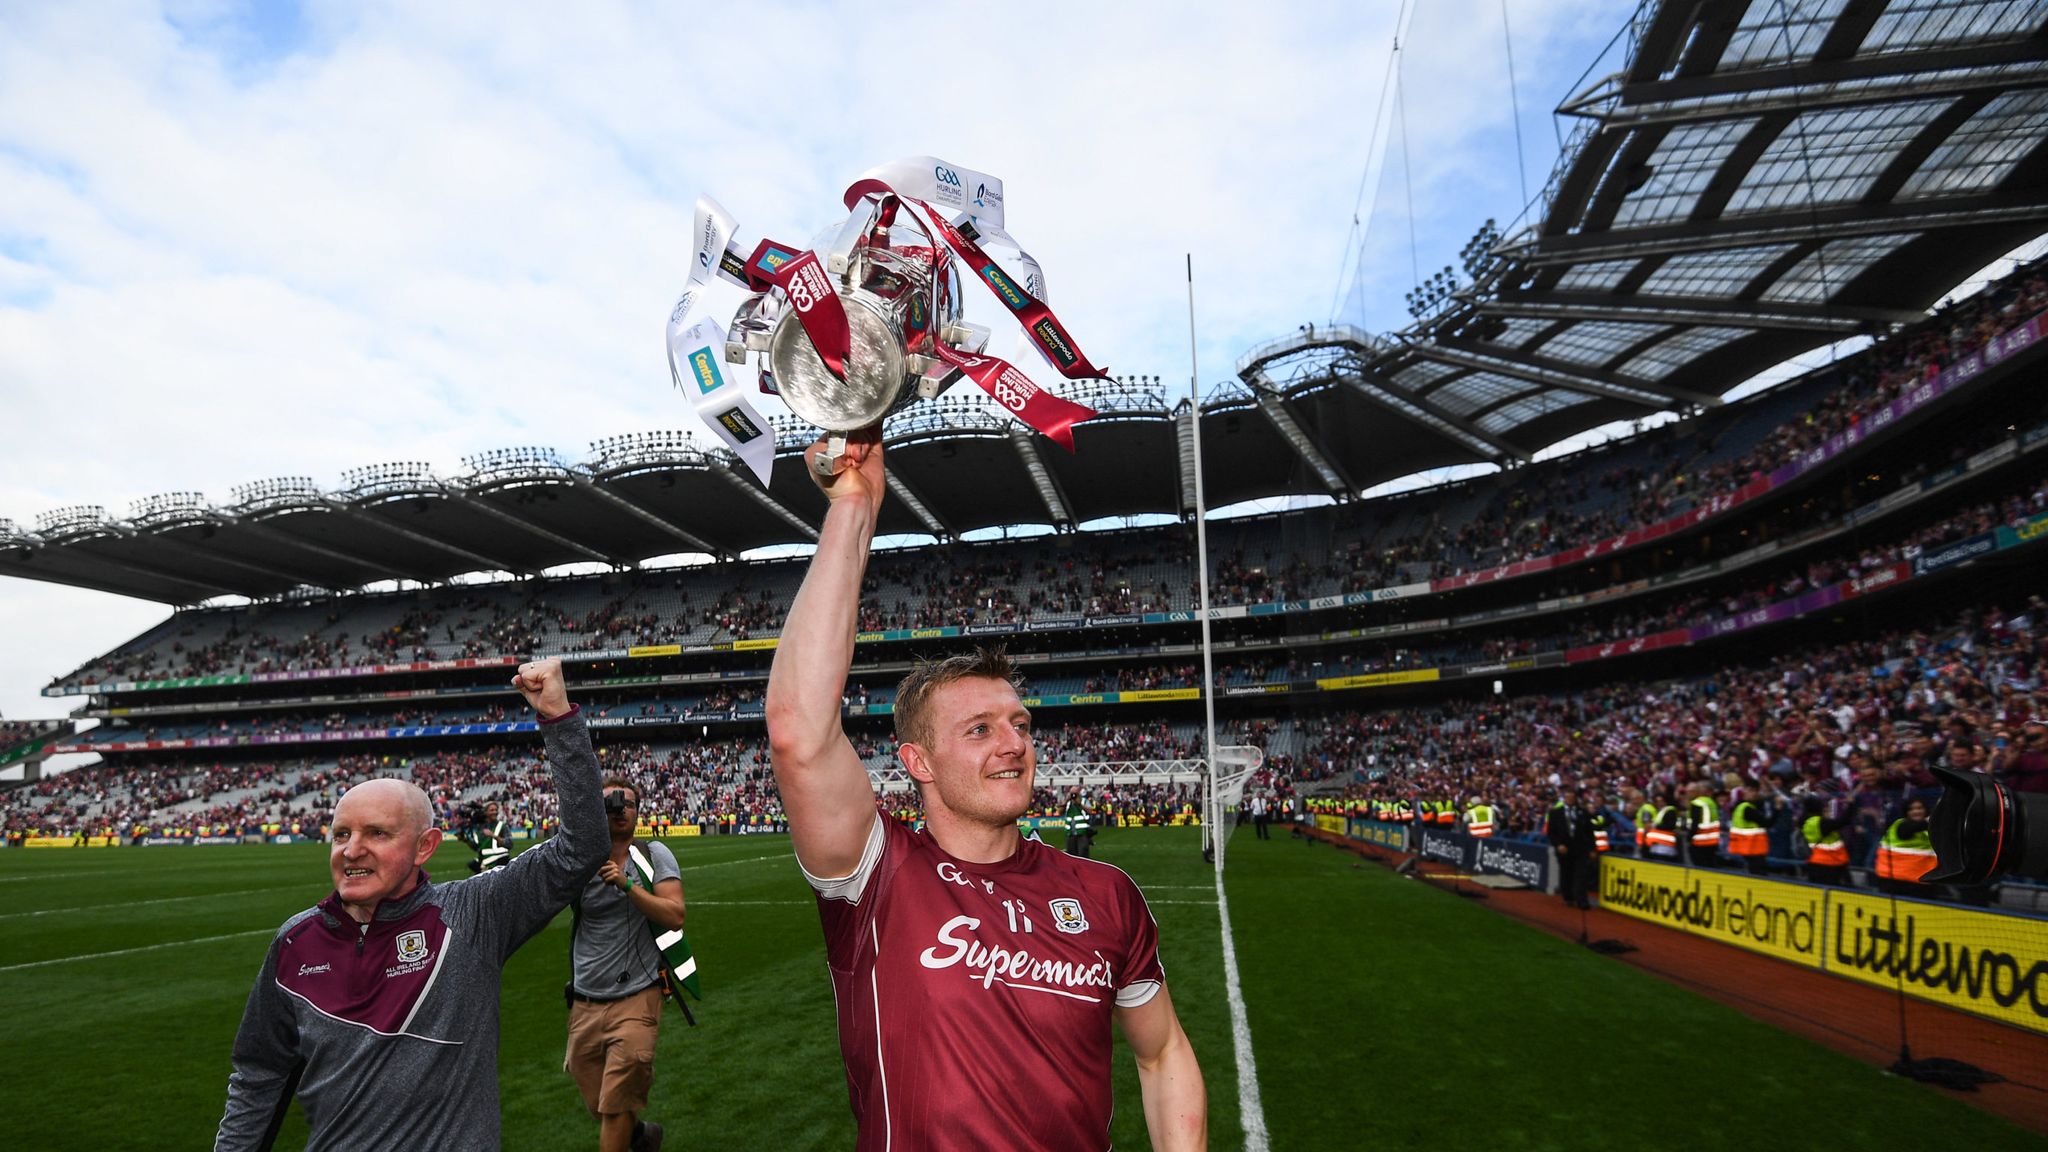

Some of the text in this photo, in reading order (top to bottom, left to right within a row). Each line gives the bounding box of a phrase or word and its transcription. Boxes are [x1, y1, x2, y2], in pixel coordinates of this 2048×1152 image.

[935, 166, 961, 188] GAA
[937, 184, 962, 197] HURLING
[799, 266, 824, 302] HURLING
[989, 270, 1020, 304] Centra
[787, 271, 814, 313] GAA
[1037, 325, 1058, 350] Ireland
[1043, 321, 1073, 360] Littlewoods
[695, 353, 715, 387] Centra
[1000, 372, 1033, 400] HURLING
[994, 378, 1026, 411] GAA
[1092, 618, 1107, 626] Bord
[1120, 616, 1139, 624] Energy
[1170, 612, 1189, 621] GAA
[855, 633, 884, 643] Centra
[911, 629, 942, 638] Centra
[1022, 698, 1041, 706] ntra
[1070, 695, 1103, 704] Centra
[591, 718, 625, 726] MUSEUM
[387, 967, 411, 978] HURLING
[396, 962, 421, 972] IRELAND
